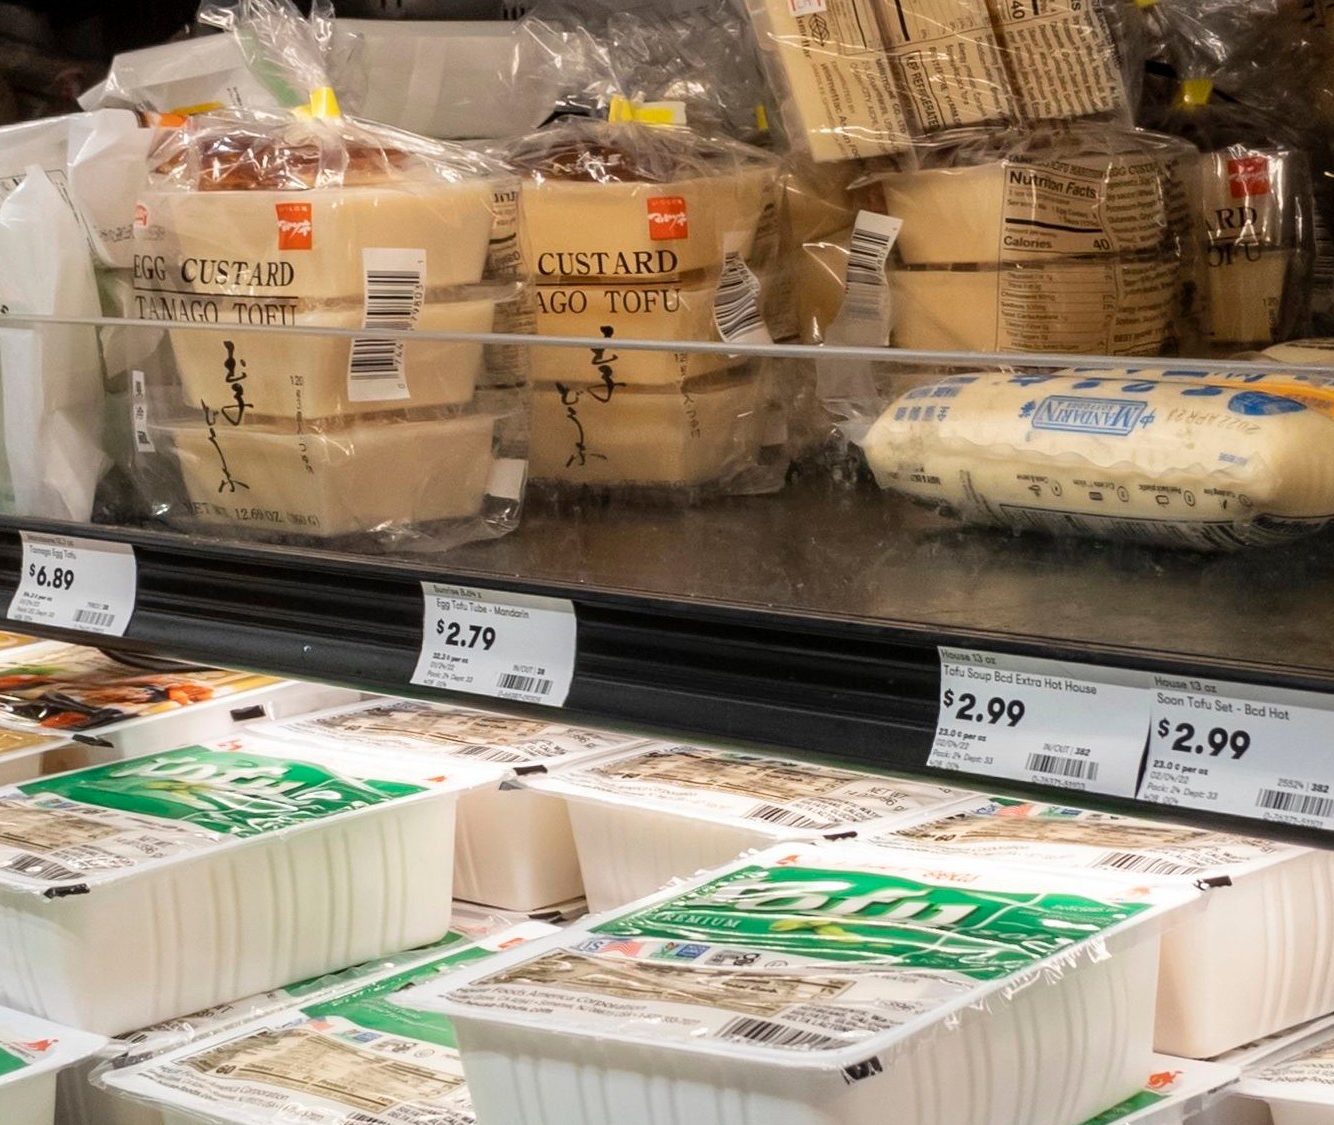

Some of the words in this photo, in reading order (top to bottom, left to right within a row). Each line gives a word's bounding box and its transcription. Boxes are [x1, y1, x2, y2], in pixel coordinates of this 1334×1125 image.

[133, 255, 166, 281] EGG
[181, 258, 295, 287] CUSTARD
[537, 250, 678, 276] CUSTARD
[134, 295, 219, 323] TAMAGO
[232, 302, 298, 326] TOFU
[604, 287, 682, 314] TOFU
[29, 562, 74, 590] $6.89
[436, 599, 450, 611] Egg
[436, 618, 497, 651] $2.79
[941, 649, 970, 662] House
[973, 653, 984, 663] 13
[944, 664, 965, 678] Tofu
[968, 667, 992, 683] Soup
[994, 671, 1013, 684] Bcd
[1016, 674, 1042, 688] Extra
[1045, 678, 1062, 691] Hot
[1065, 681, 1098, 695] House
[1155, 676, 1187, 690] House
[1190, 680, 1202, 691] 13
[1205, 684, 1217, 693] oz
[943, 688, 1025, 727] $2.99
[1157, 692, 1184, 707] Soon
[1187, 696, 1211, 710] Tofu
[1215, 700, 1233, 713] Set
[1245, 703, 1266, 717] Bcd
[1269, 707, 1290, 721] Hot
[1158, 717, 1251, 760] $2.99
[1153, 759, 1173, 769] 23.0
[1181, 765, 1196, 775] per
[1311, 783, 1330, 794] 382
